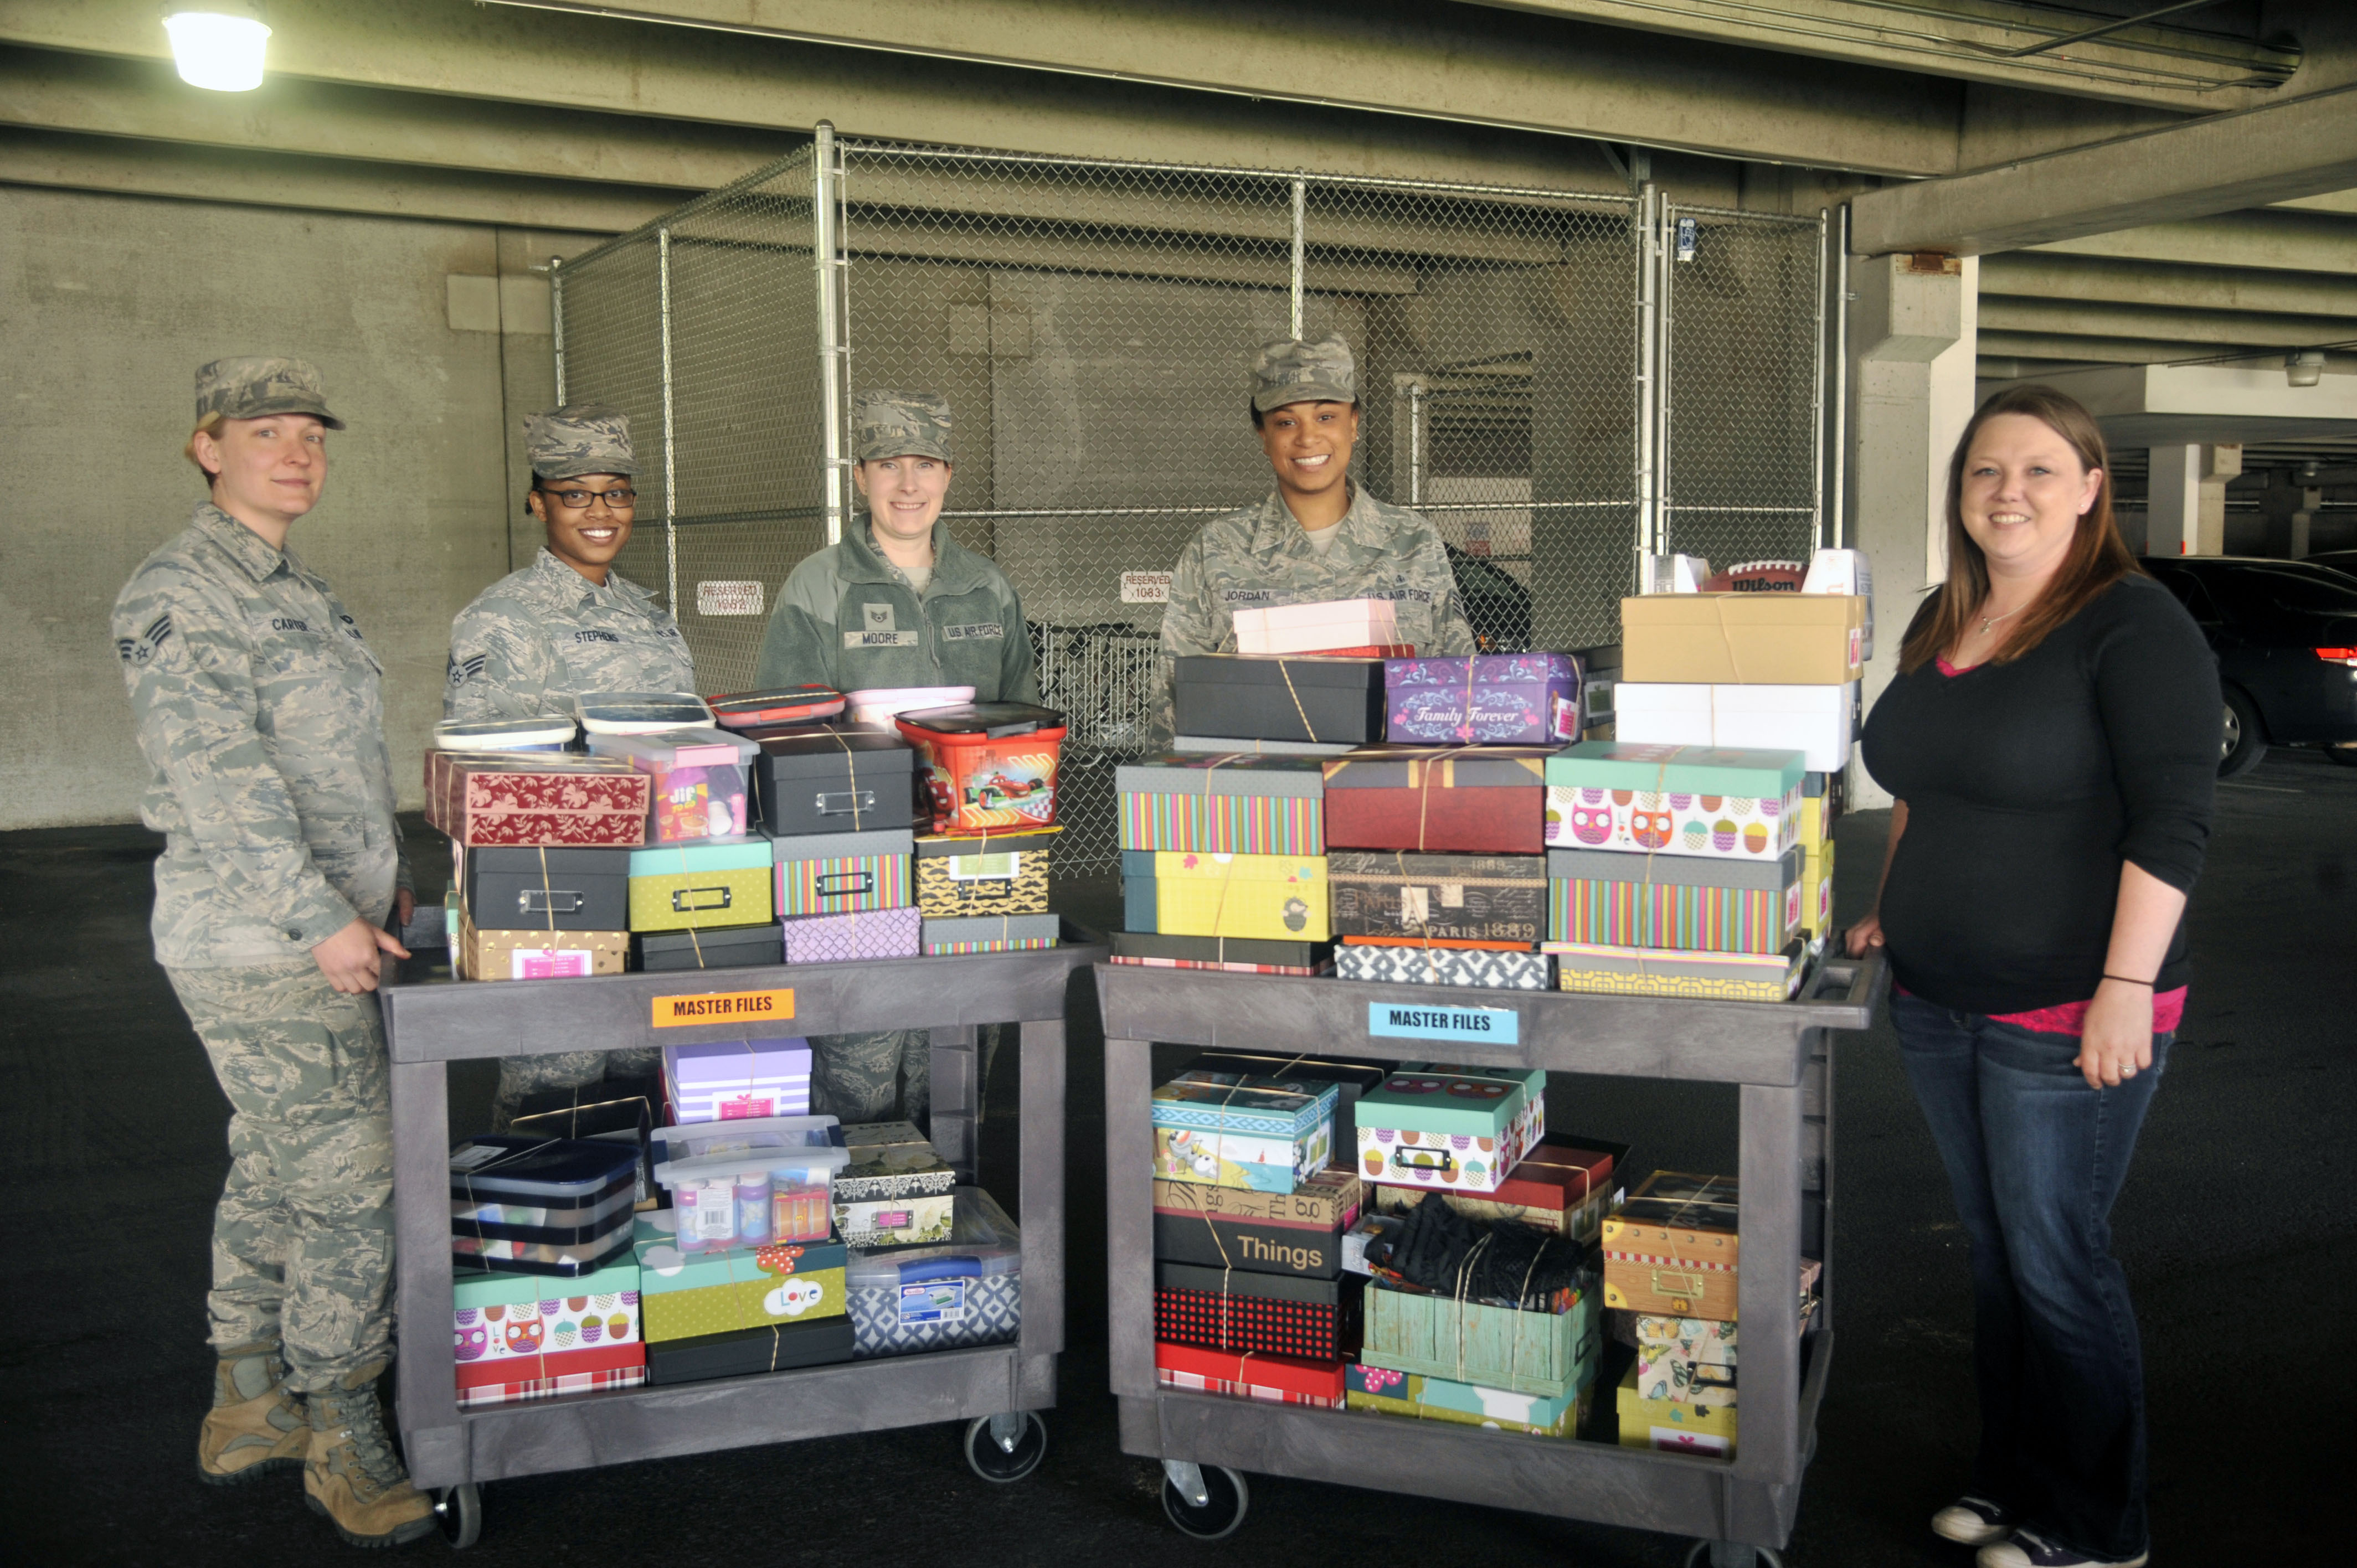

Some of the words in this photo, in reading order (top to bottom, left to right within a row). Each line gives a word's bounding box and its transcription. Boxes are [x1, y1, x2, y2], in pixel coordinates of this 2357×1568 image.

[1126, 575, 1170, 585] RESERVED
[1732, 577, 1795, 592] Wilson
[704, 585, 756, 596] RESERVED
[1225, 590, 1270, 601] JORDAN
[1389, 589, 1407, 601] AIR
[1409, 589, 1432, 602] FORCE
[272, 618, 310, 632] CARTER
[964, 625, 978, 636] AIR
[979, 623, 1002, 636] FORCE
[574, 630, 619, 643] STEPHENS
[862, 633, 898, 644] MOORE
[1414, 706, 1462, 727] Family
[1467, 706, 1519, 723] Forever
[670, 786, 696, 803] Jif
[1471, 859, 1505, 871] 1889
[1428, 925, 1479, 940] PARIS
[1484, 921, 1536, 939] 1889
[674, 999, 732, 1016] MASTER
[737, 996, 772, 1012] FILES
[1390, 1010, 1448, 1029] MASTER
[1453, 1014, 1490, 1031] FILES
[1237, 1235, 1324, 1271] Things
